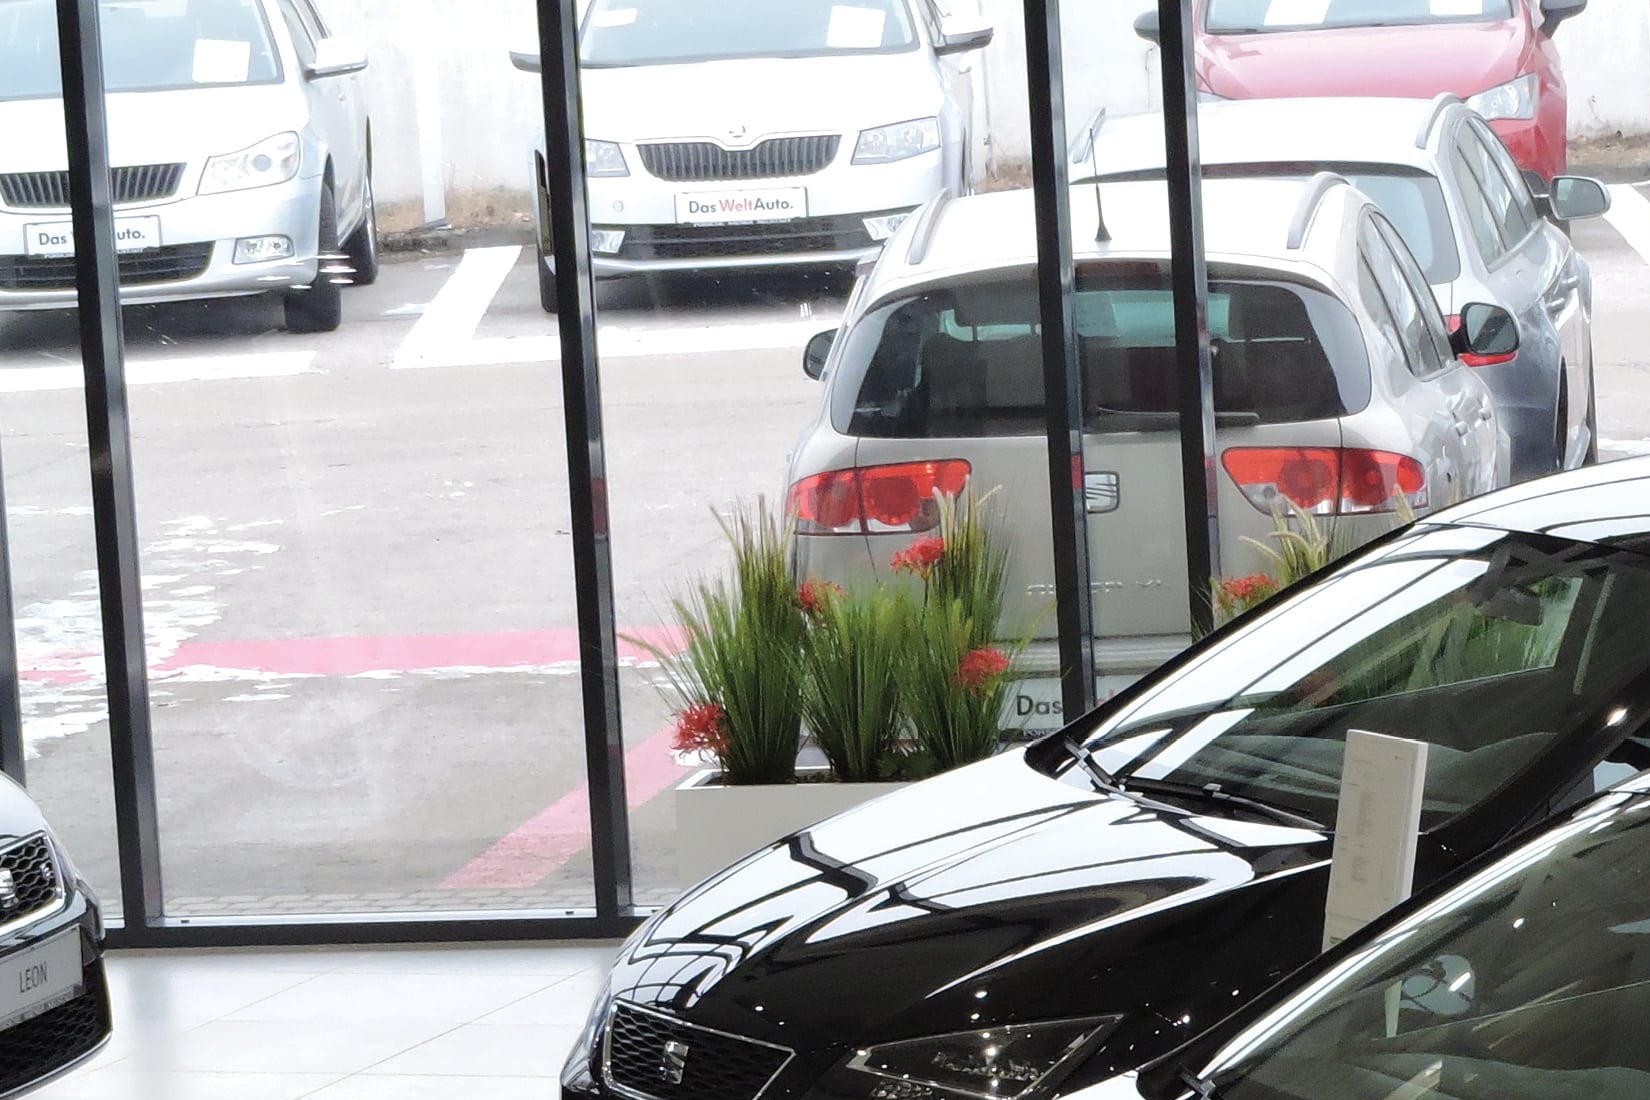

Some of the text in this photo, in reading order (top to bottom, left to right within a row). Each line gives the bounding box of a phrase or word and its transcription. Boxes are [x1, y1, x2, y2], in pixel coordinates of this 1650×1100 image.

[688, 197, 794, 214] Das WeltAuto.
[38, 232, 68, 246] Das
[1016, 695, 1063, 716] Das
[18, 960, 48, 993] LEON
